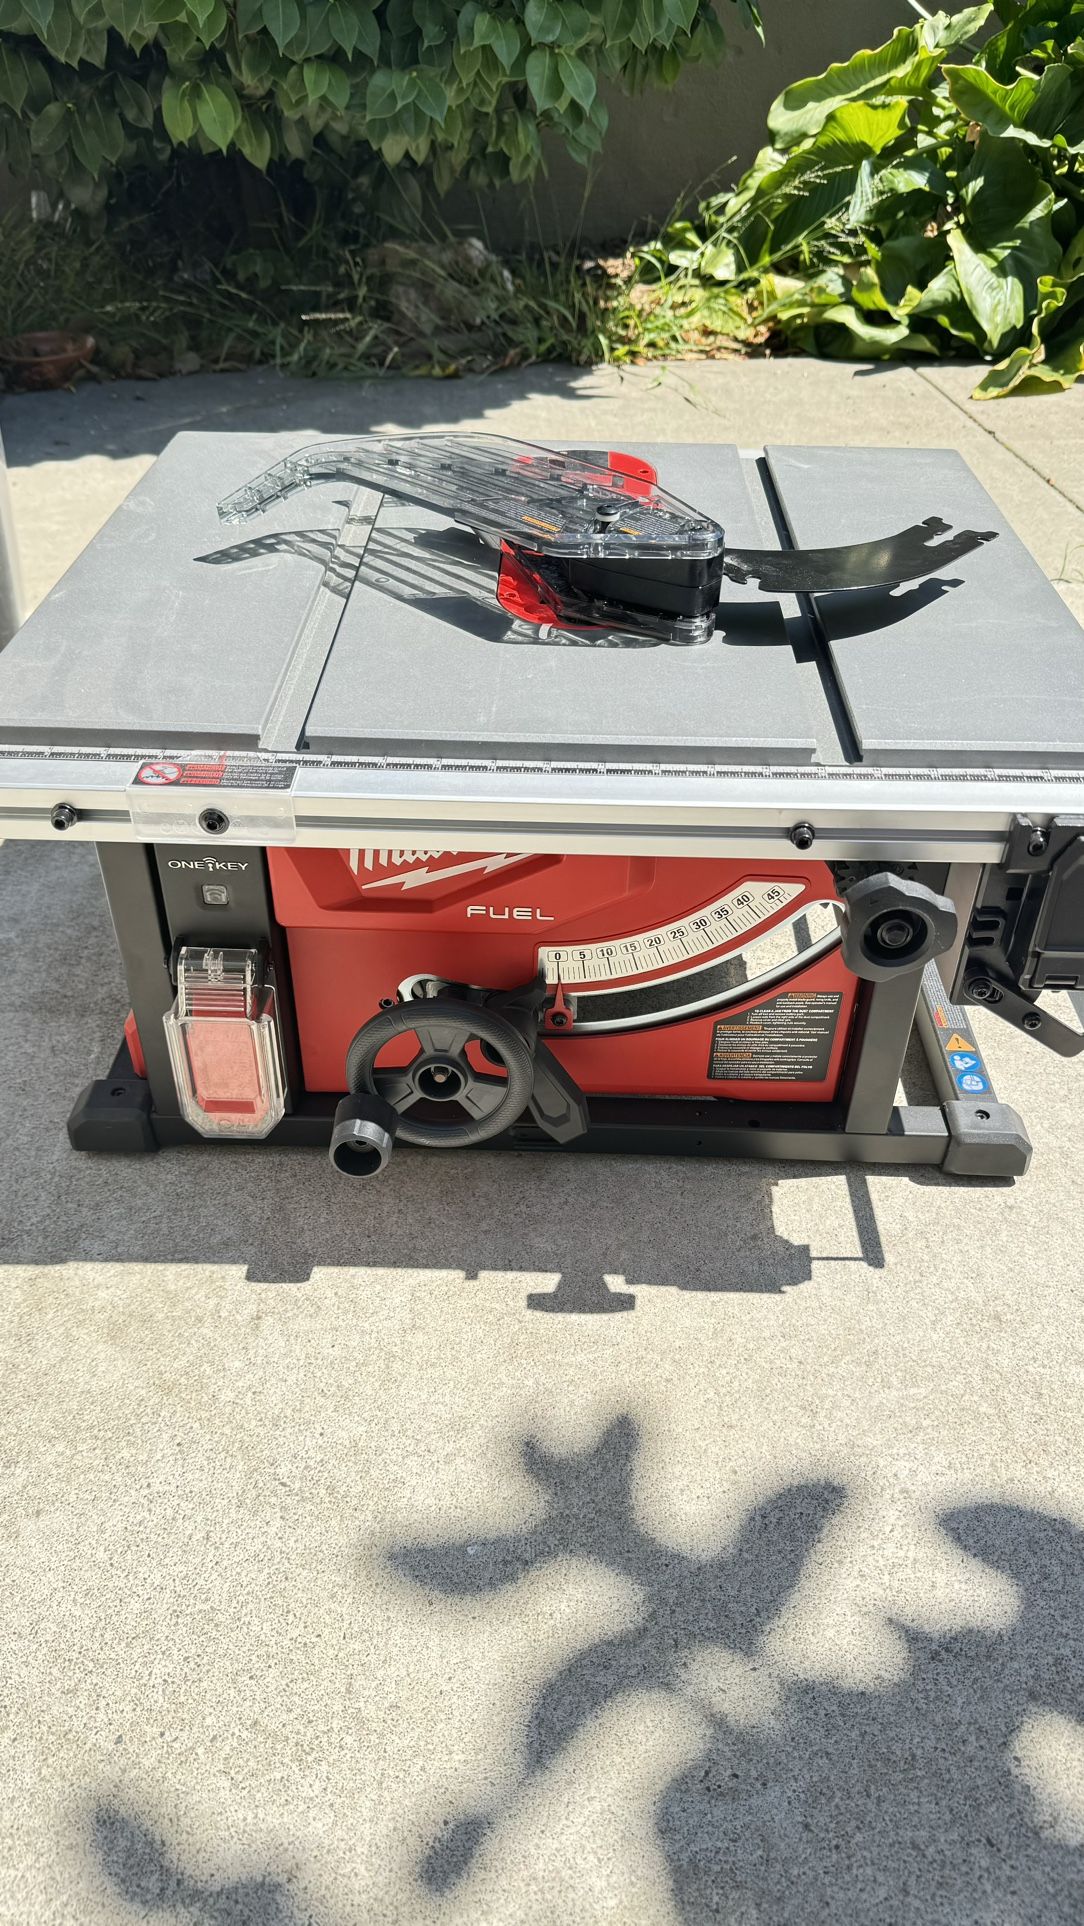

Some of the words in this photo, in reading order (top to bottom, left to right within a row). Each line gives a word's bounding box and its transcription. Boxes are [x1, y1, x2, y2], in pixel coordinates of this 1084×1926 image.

[466, 905, 555, 921] FUEL
[554, 952, 562, 960] 0
[579, 951, 586, 960] 5
[600, 947, 613, 957] 10
[624, 943, 637, 952] 15
[647, 936, 662, 947] 20
[670, 928, 685, 939] 25
[692, 918, 708, 930] 30
[714, 907, 729, 920] 35
[736, 894, 750, 907] 40
[766, 888, 781, 901] 45
